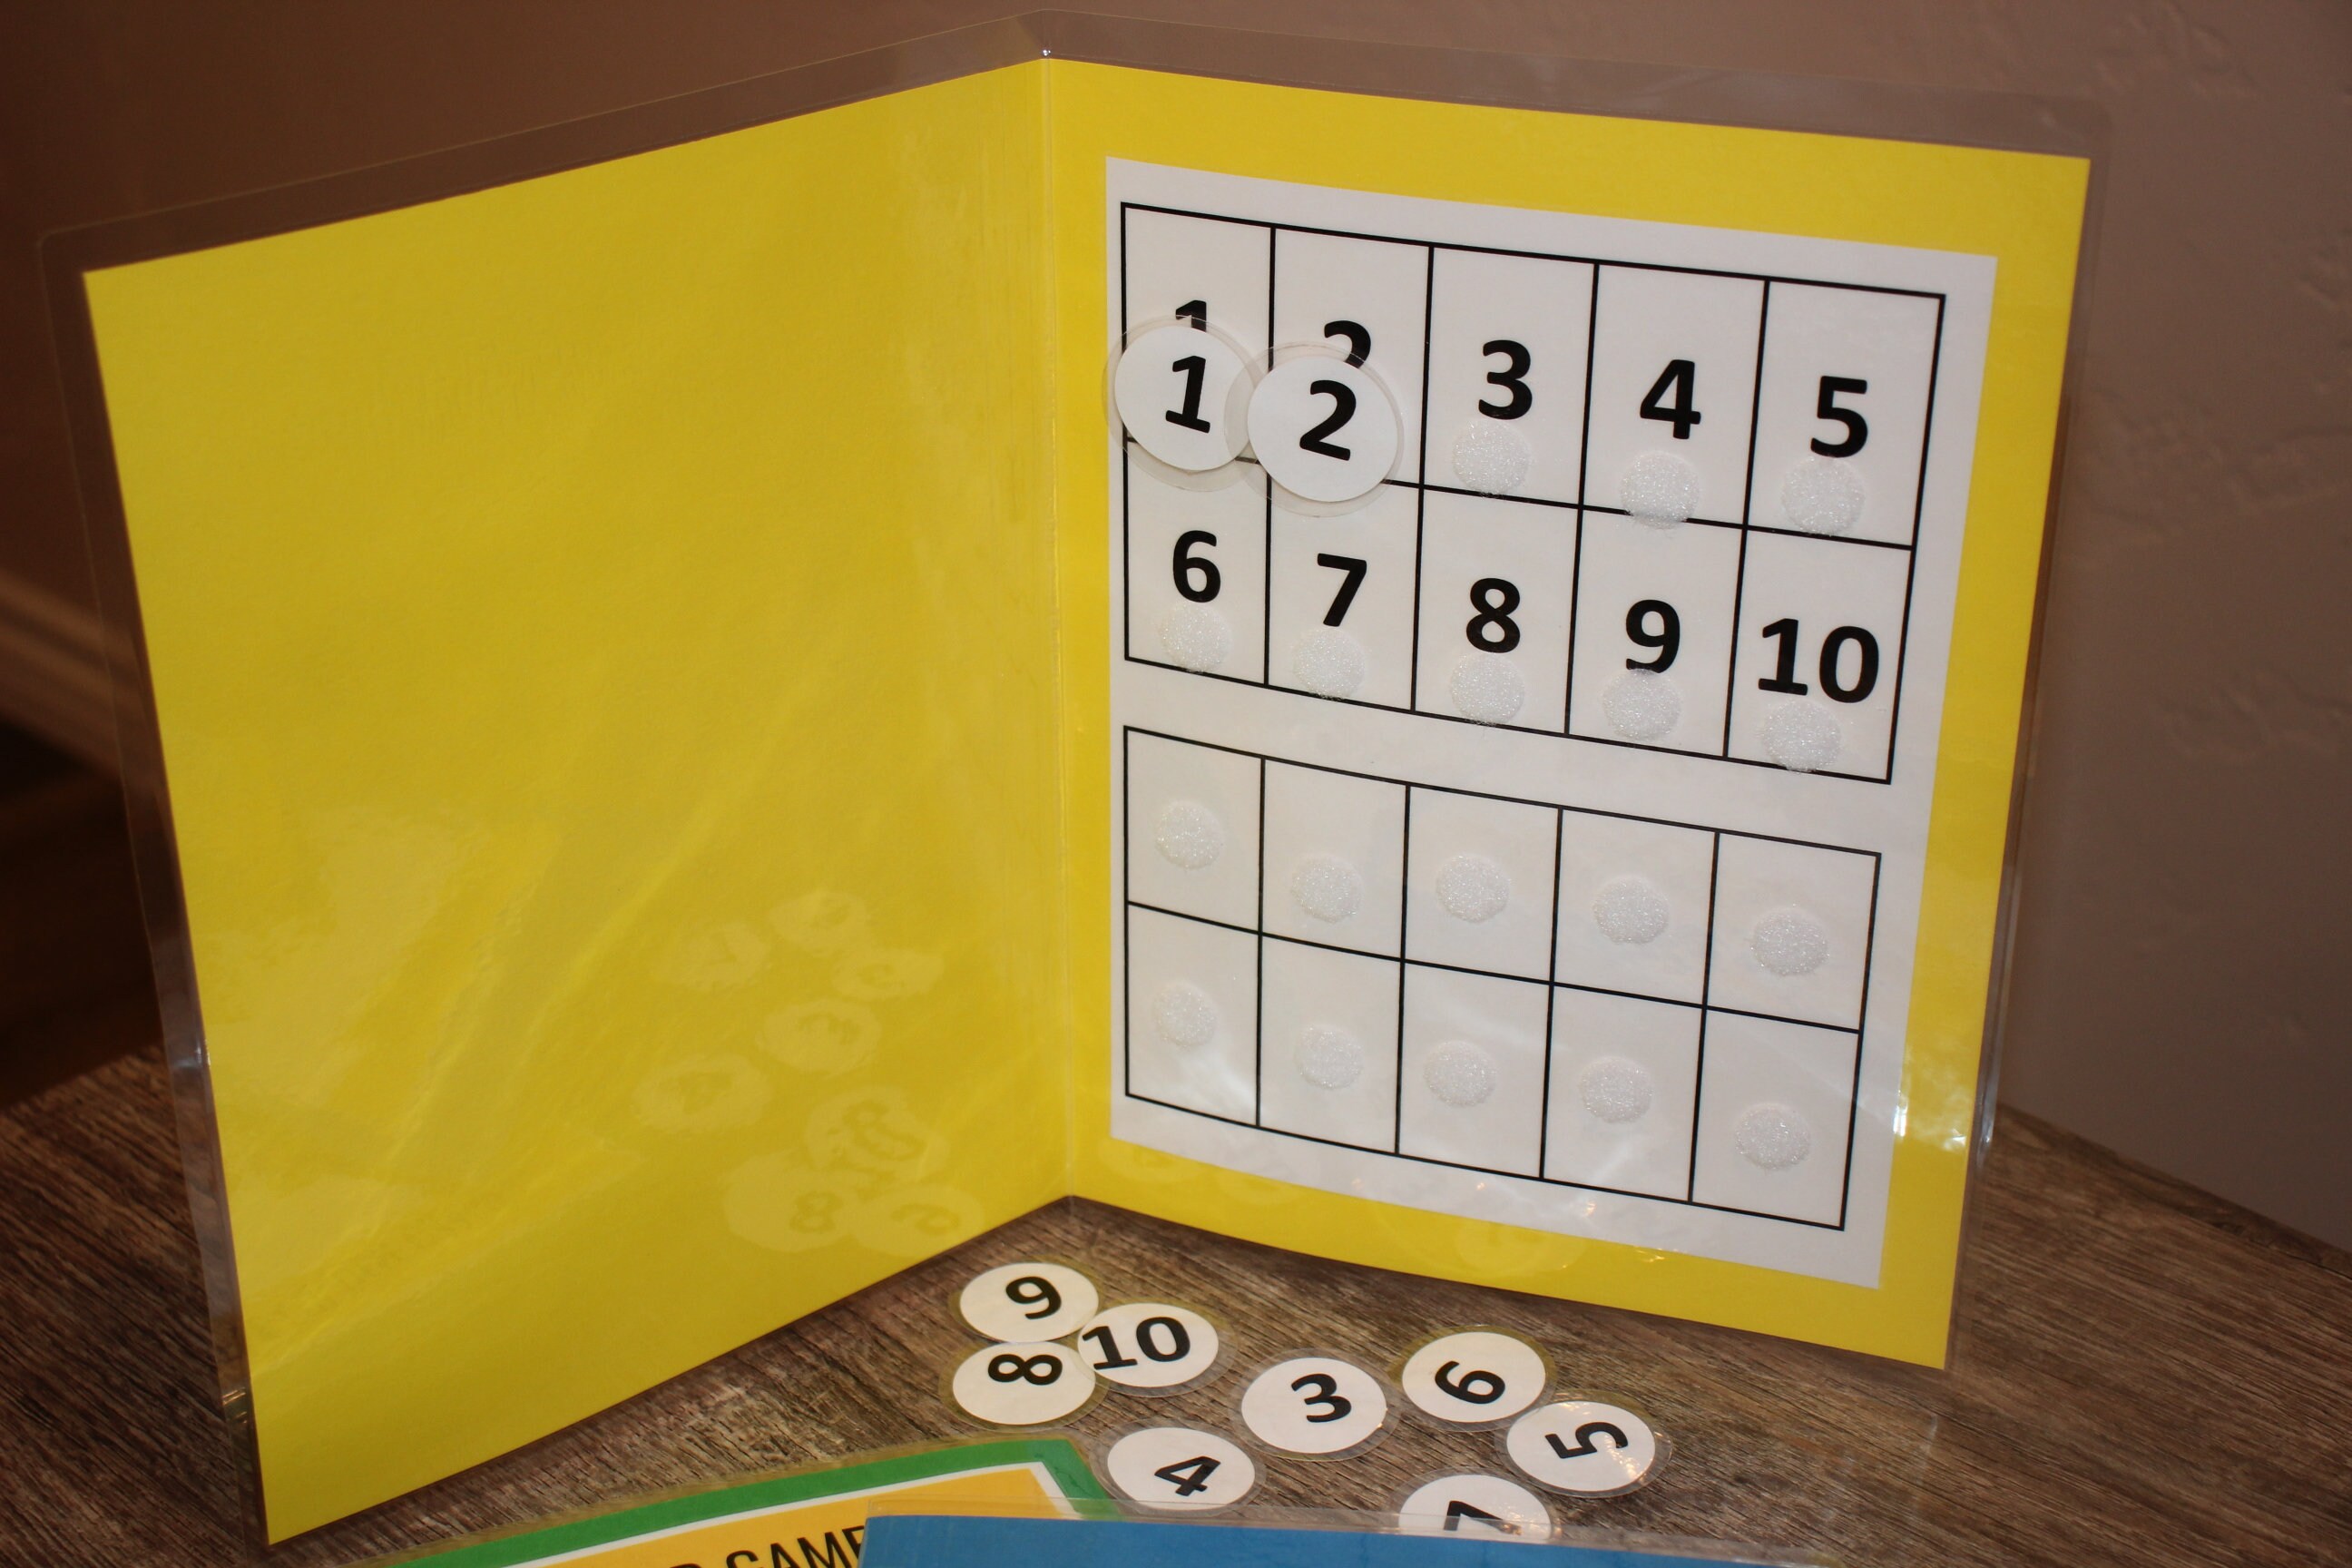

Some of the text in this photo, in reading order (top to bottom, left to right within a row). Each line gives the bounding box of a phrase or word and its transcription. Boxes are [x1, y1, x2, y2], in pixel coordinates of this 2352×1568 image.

[1165, 355, 1210, 434] 1
[1478, 339, 1534, 420] 3
[1639, 358, 1701, 440] 4
[1810, 375, 1869, 458] 5
[1298, 379, 1357, 461] 2
[1172, 530, 1880, 704] 6 7 8 9 10
[1004, 1275, 1063, 1321] 9
[1081, 1316, 1191, 1371] 10
[986, 1353, 1063, 1387] 8
[1433, 1359, 1507, 1406] 6
[1289, 1372, 1353, 1424] 3
[1544, 1421, 1630, 1460] 5
[1152, 1455, 1222, 1498] 4
[1443, 1500, 1524, 1536] 7
